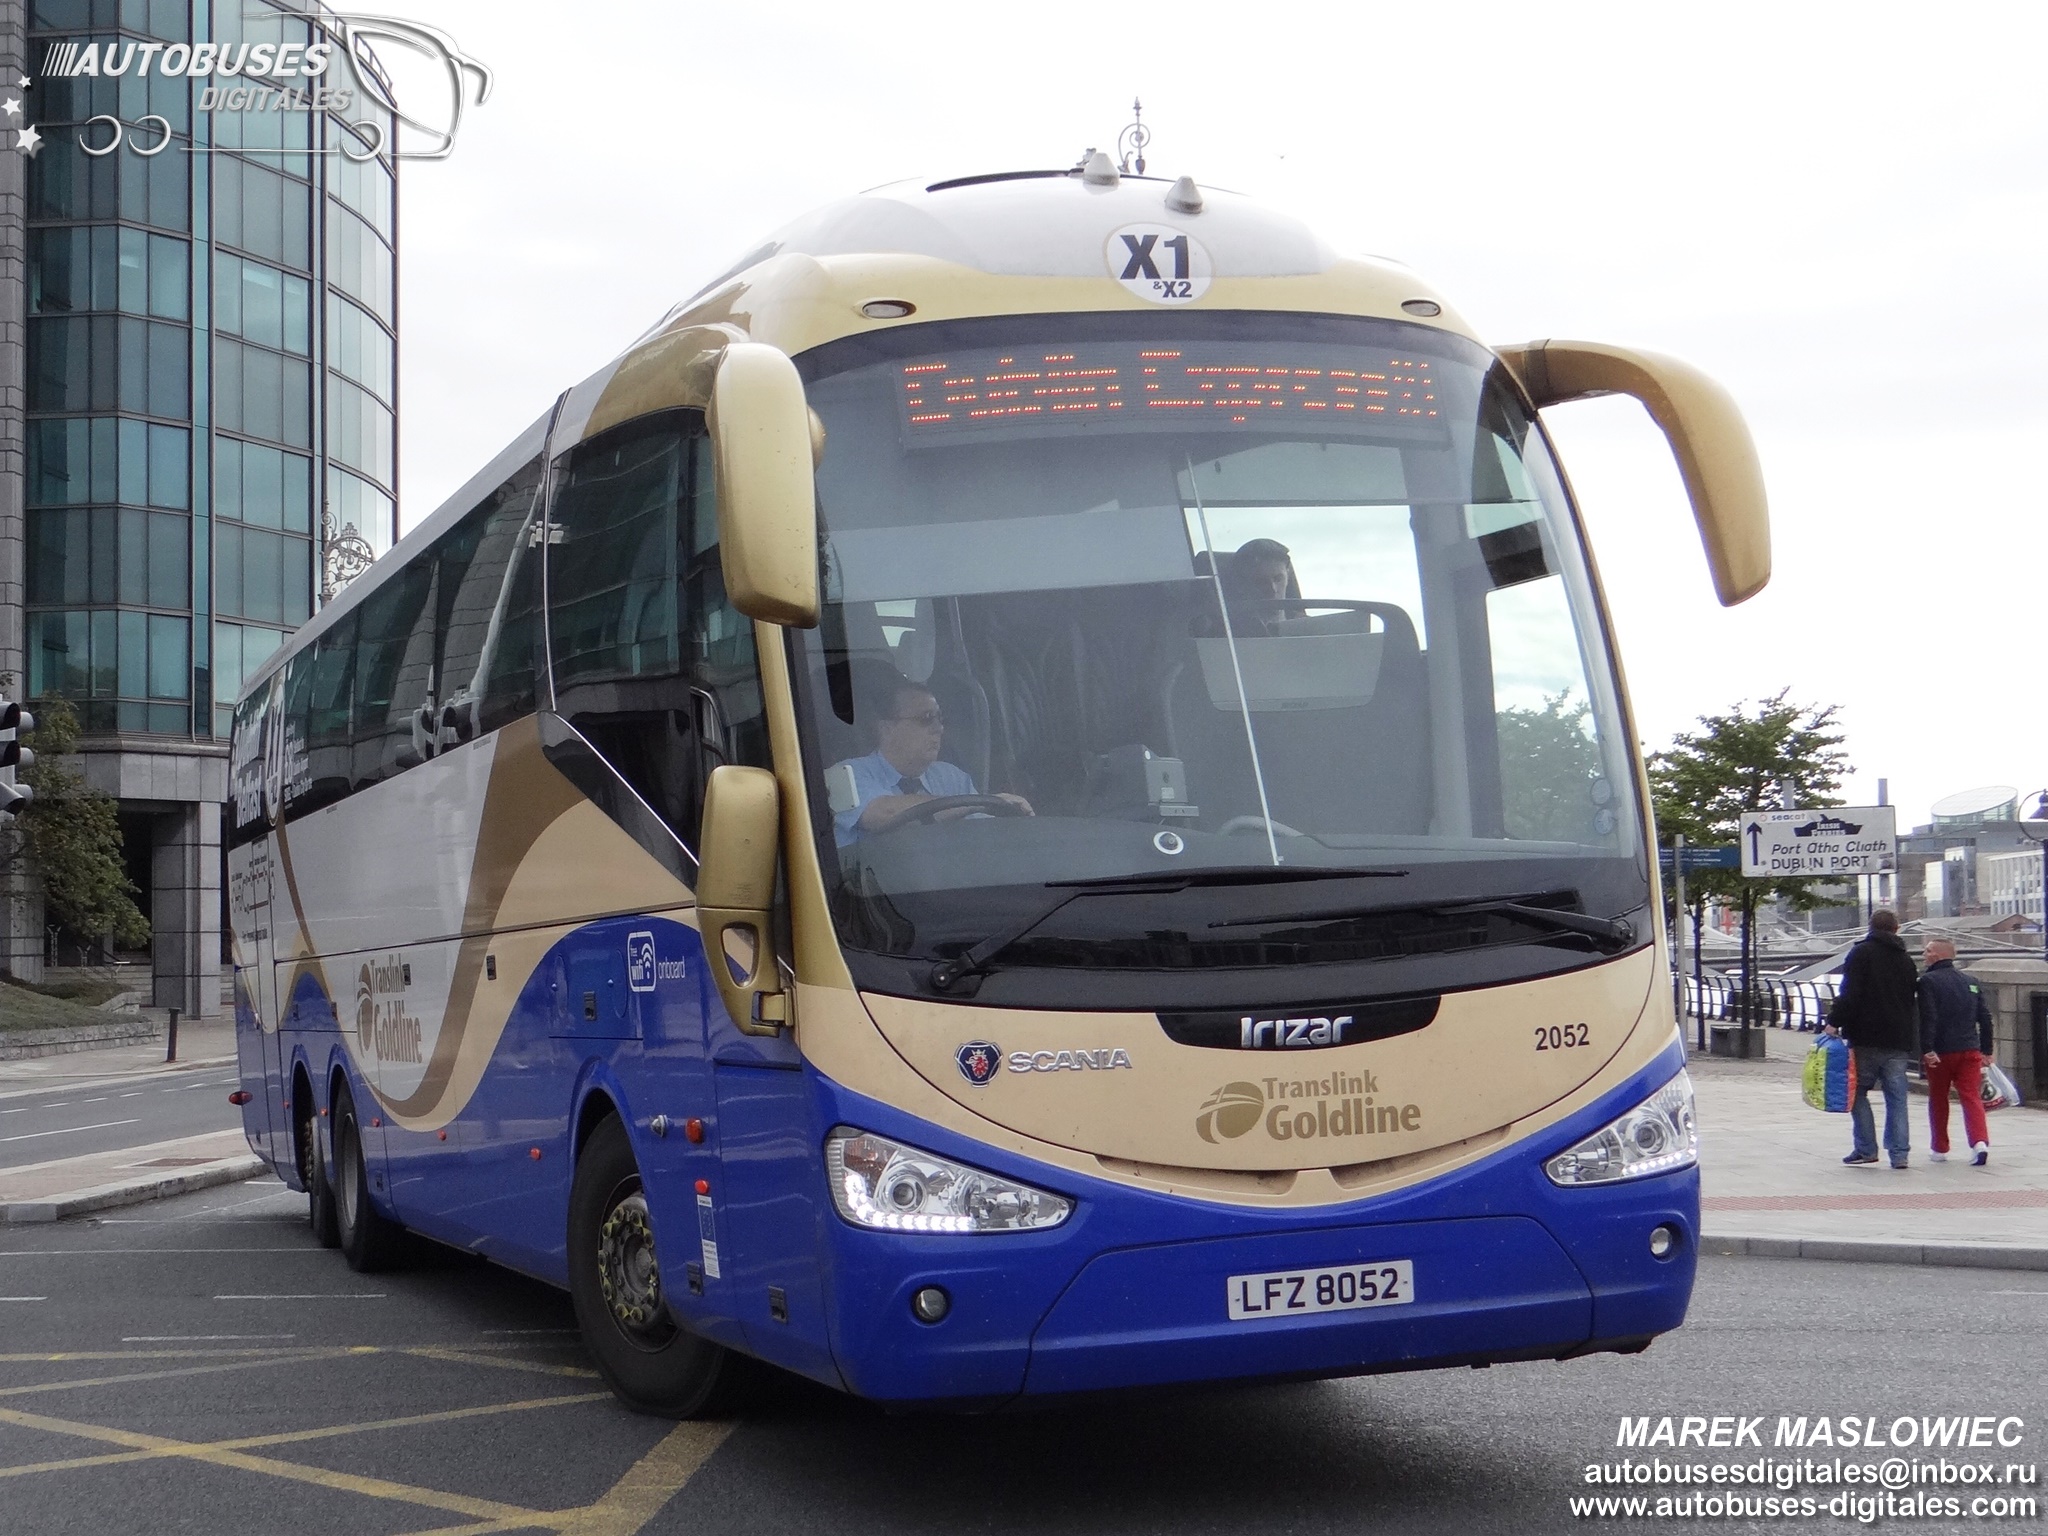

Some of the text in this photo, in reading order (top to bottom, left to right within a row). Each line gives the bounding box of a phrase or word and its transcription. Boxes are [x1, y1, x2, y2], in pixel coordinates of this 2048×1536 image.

[1120, 234, 1190, 279] X1
[1771, 812, 1806, 821] seacat
[1771, 842, 1802, 855] Port
[1771, 857, 1824, 870] DUBLIN
[1830, 855, 1870, 868] PORT
[657, 955, 686, 979] onboard
[374, 999, 423, 1064] Goldline
[1535, 1022, 1591, 1051] 2052
[1008, 1047, 1133, 1073] SCANIA
[1262, 1069, 1379, 1100] Translink
[1265, 1096, 1422, 1141] Goldline
[1241, 1267, 1400, 1313] LFZ 8052
